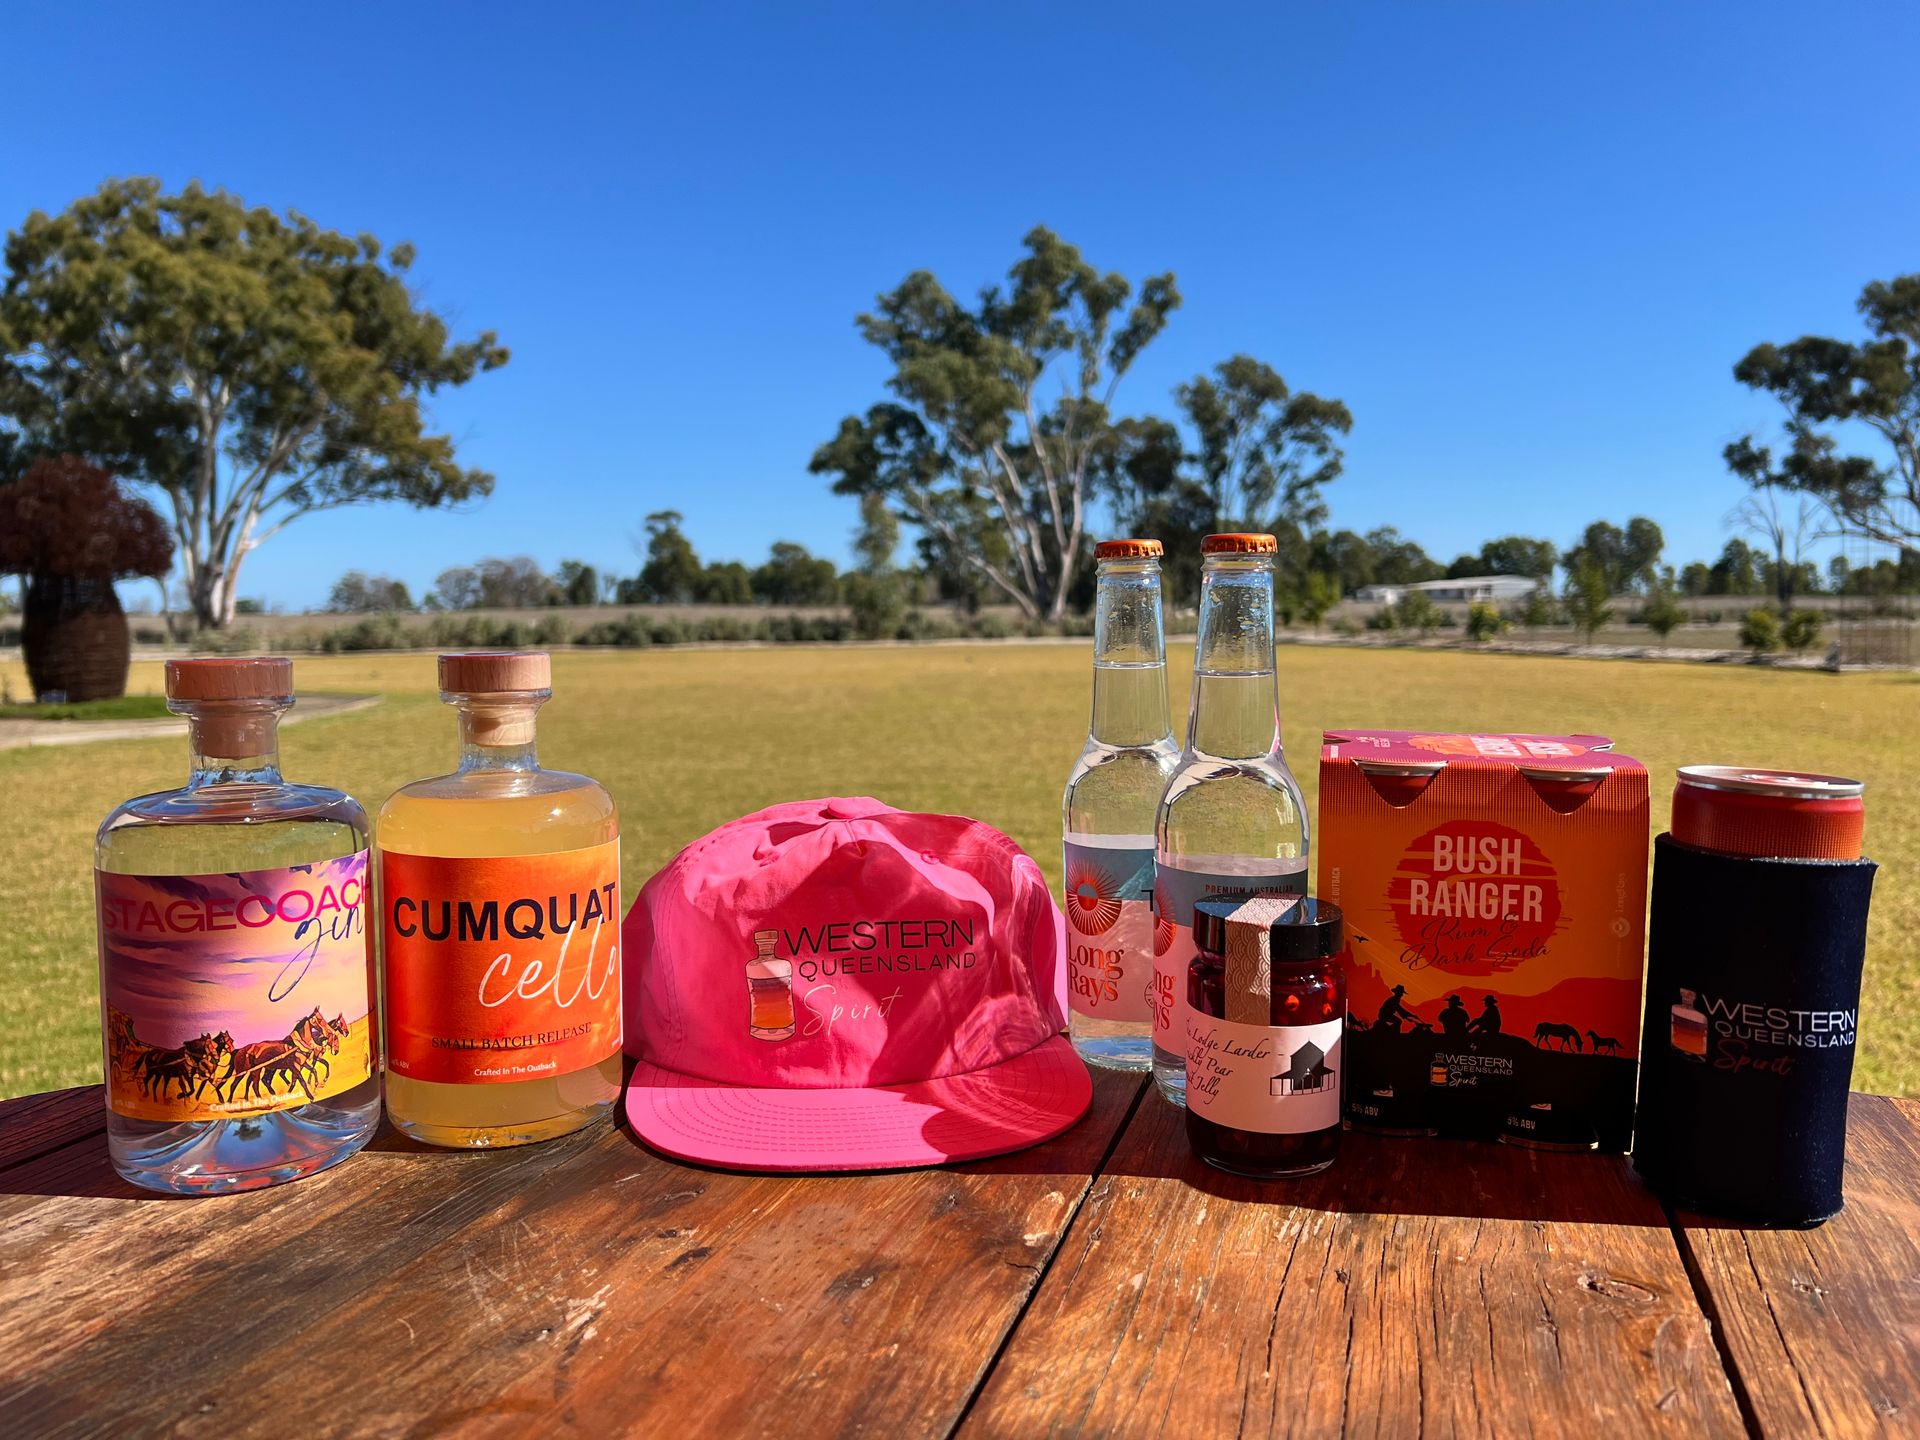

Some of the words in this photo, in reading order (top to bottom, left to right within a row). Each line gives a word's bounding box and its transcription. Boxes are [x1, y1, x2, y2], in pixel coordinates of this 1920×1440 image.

[1433, 834, 1522, 875] BUSH
[1205, 884, 1246, 894] PREMIUM
[1409, 879, 1543, 922] RANGER
[393, 881, 616, 941] CUMQUAT
[783, 919, 975, 956] WESTERN
[1421, 917, 1490, 942] Rum
[1500, 912, 1521, 934] &
[268, 906, 363, 1002] gin
[799, 952, 977, 982] QUEENSLAND
[1068, 932, 1125, 980] Long
[1400, 942, 1477, 971] Dark
[1486, 935, 1552, 967] Soda
[1068, 962, 1119, 1007] Rays
[802, 984, 903, 1037] Spirit
[1702, 993, 1856, 1033] WESTERN
[431, 1037, 478, 1050] SMALL
[481, 1034, 533, 1050] BATCH
[537, 1022, 592, 1045] RELEASE
[1222, 1038, 1271, 1060] Larder
[1714, 1020, 1855, 1048] QUEENSLAND
[474, 1068, 501, 1076] Crafted
[502, 1067, 510, 1075] In
[512, 1066, 526, 1074] The
[526, 1060, 557, 1072] Outback
[1206, 1056, 1234, 1077] Pear
[1445, 1053, 1513, 1069] WESTERN
[1449, 1064, 1513, 1076] QUEENSLAND
[1714, 1038, 1797, 1076] Spirit
[1193, 1075, 1221, 1105] Jelly
[1449, 1071, 1479, 1087] Spirit
[209, 1102, 241, 1112] Crafted
[242, 1100, 251, 1109] In
[252, 1097, 269, 1106] The
[1520, 1118, 1536, 1130] ABV
